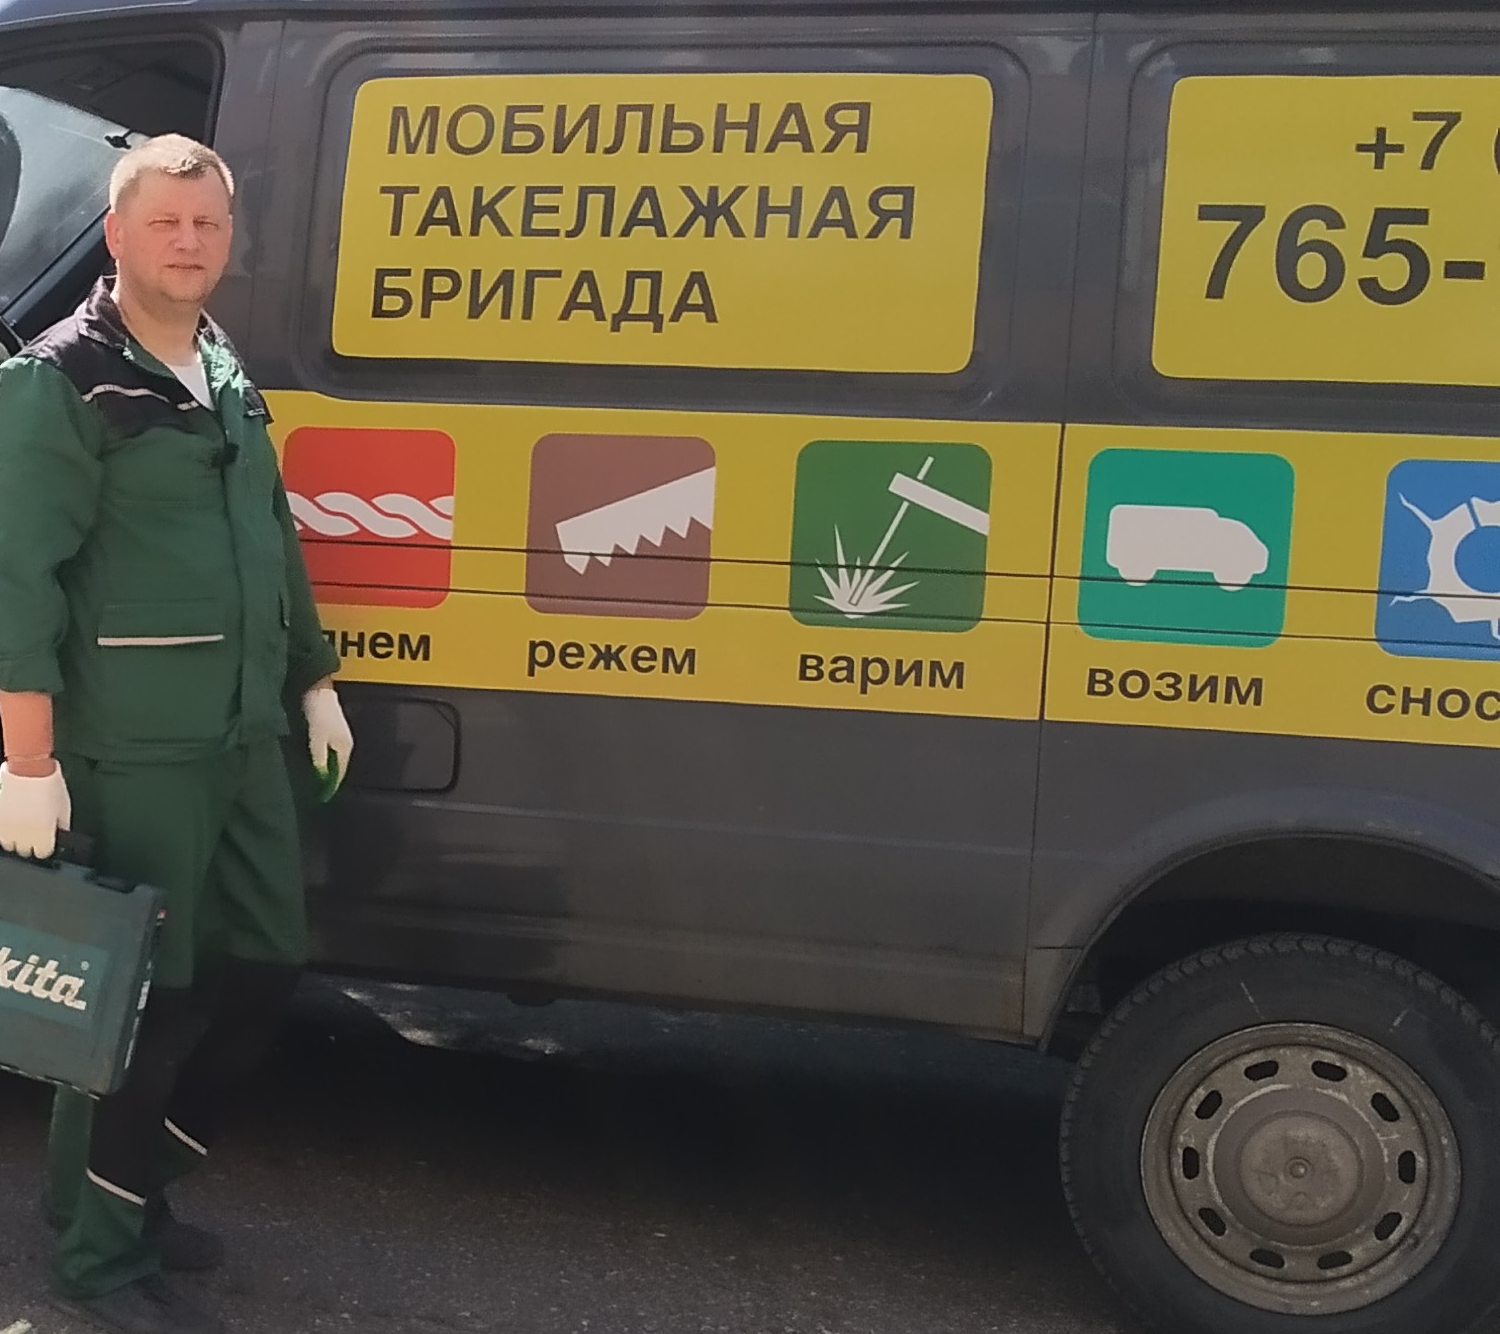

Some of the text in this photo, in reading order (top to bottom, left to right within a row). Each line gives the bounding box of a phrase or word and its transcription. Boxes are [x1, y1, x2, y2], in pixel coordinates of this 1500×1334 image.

[386, 101, 873, 156] МОБИЛЬНАЯ
[1354, 110, 1463, 172] +7
[378, 184, 917, 240] ТАКЕЛАЖНАЯ
[1196, 202, 1487, 307] 765-
[370, 266, 720, 335] БРИГАДА
[526, 639, 697, 679] режем
[797, 652, 966, 696] варим
[1085, 666, 1264, 708] возим
[1365, 683, 1500, 722] снос
